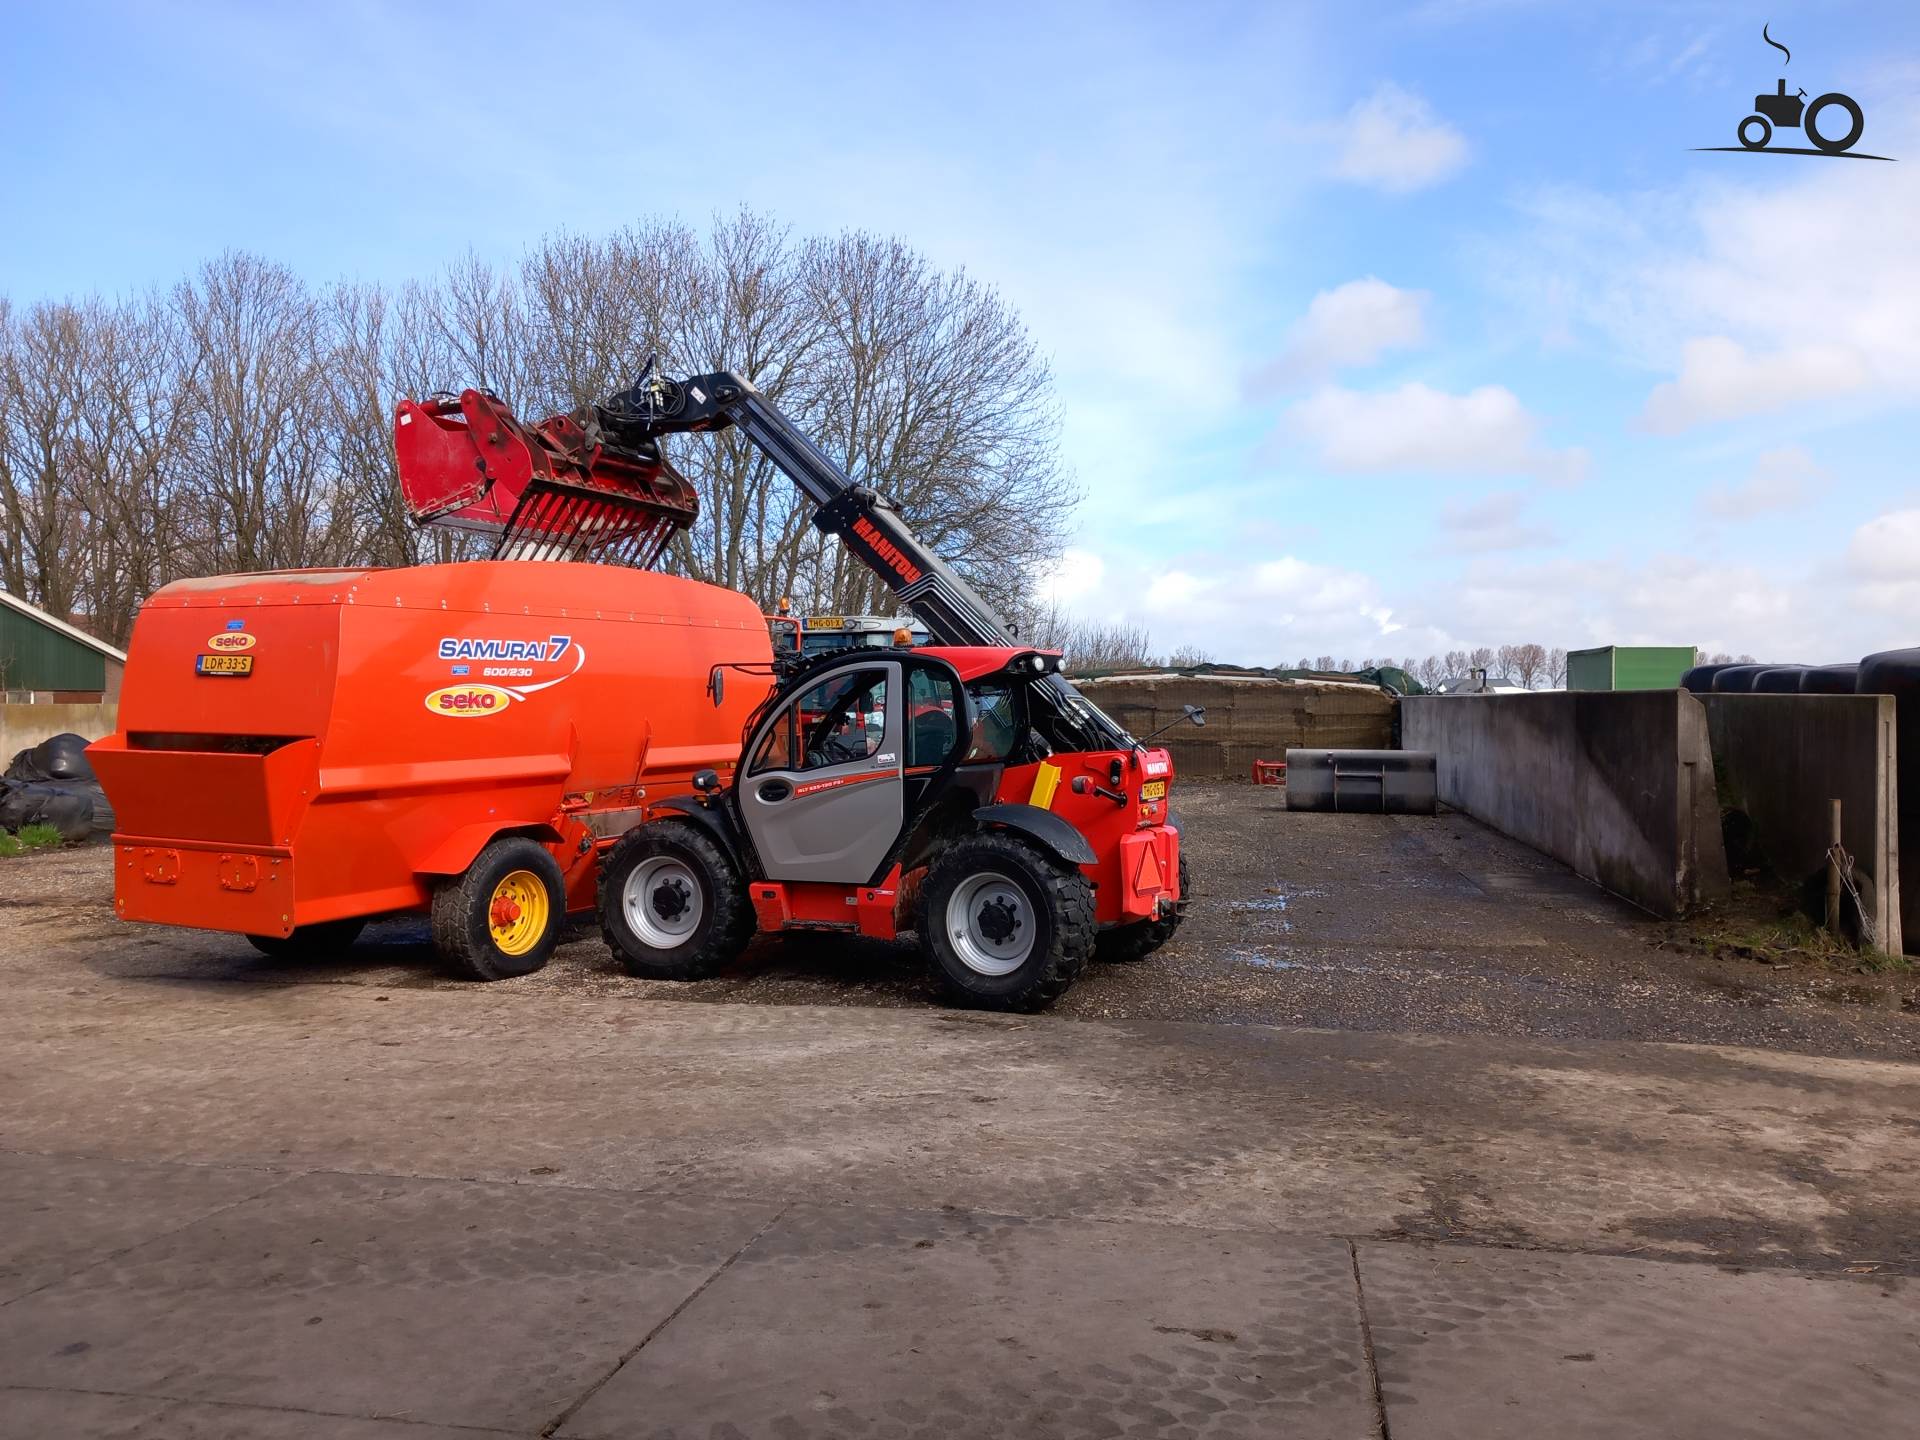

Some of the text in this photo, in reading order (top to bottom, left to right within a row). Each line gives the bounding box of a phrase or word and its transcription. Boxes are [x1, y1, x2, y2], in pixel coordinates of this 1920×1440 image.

[852, 515, 922, 584] MANITOU
[215, 635, 248, 647] seko
[438, 635, 572, 662] SAMURAI 7
[204, 657, 248, 670] LDR-33-S
[483, 667, 533, 677] 600/230
[439, 690, 497, 710] seko
